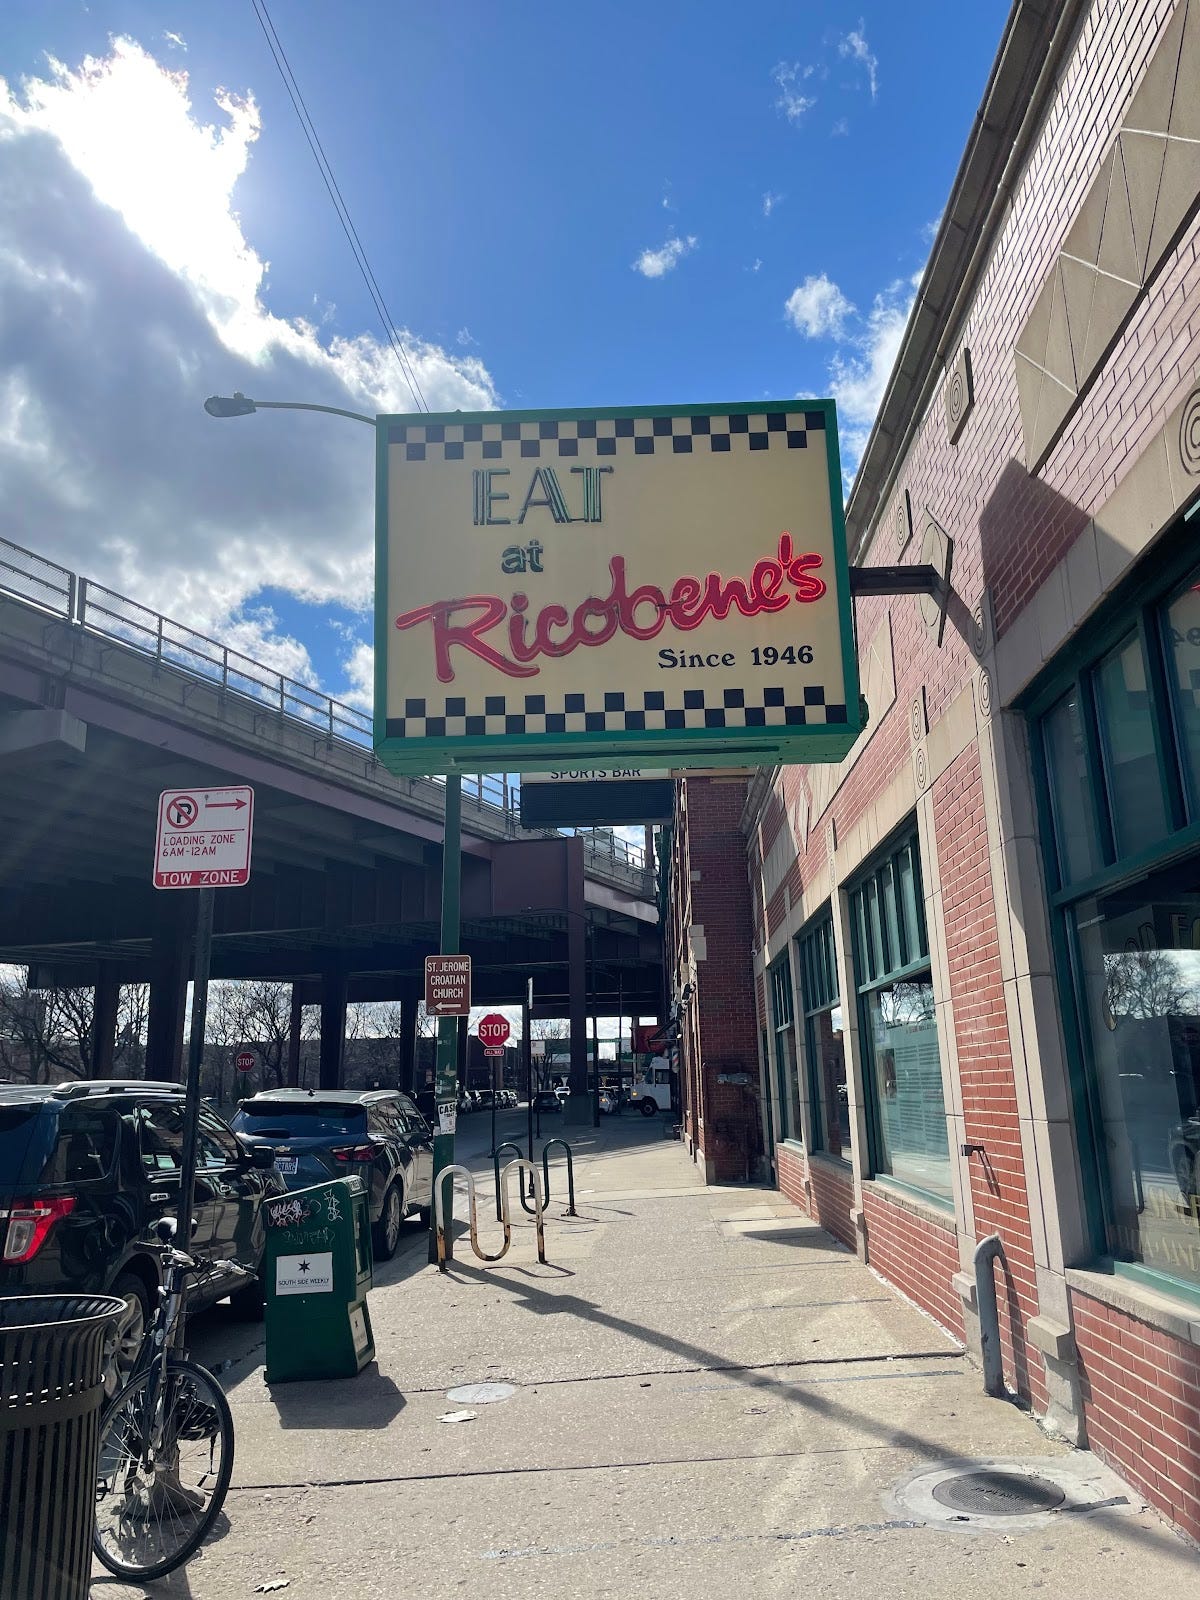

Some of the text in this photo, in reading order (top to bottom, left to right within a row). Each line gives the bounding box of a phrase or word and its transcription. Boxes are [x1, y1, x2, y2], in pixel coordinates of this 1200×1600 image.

[472, 465, 614, 525] EAT
[501, 539, 544, 573] at
[396, 531, 825, 683] Ricobene's
[658, 645, 814, 670] Since 1946
[163, 834, 236, 847] LOADING ZONE
[161, 870, 240, 885] TOW ZONE
[427, 961, 470, 972] ST. JEROME
[430, 975, 466, 985] CROATIAN
[432, 988, 464, 998] CHURCH
[480, 1023, 509, 1037] STOP
[237, 1057, 254, 1066] STOP
